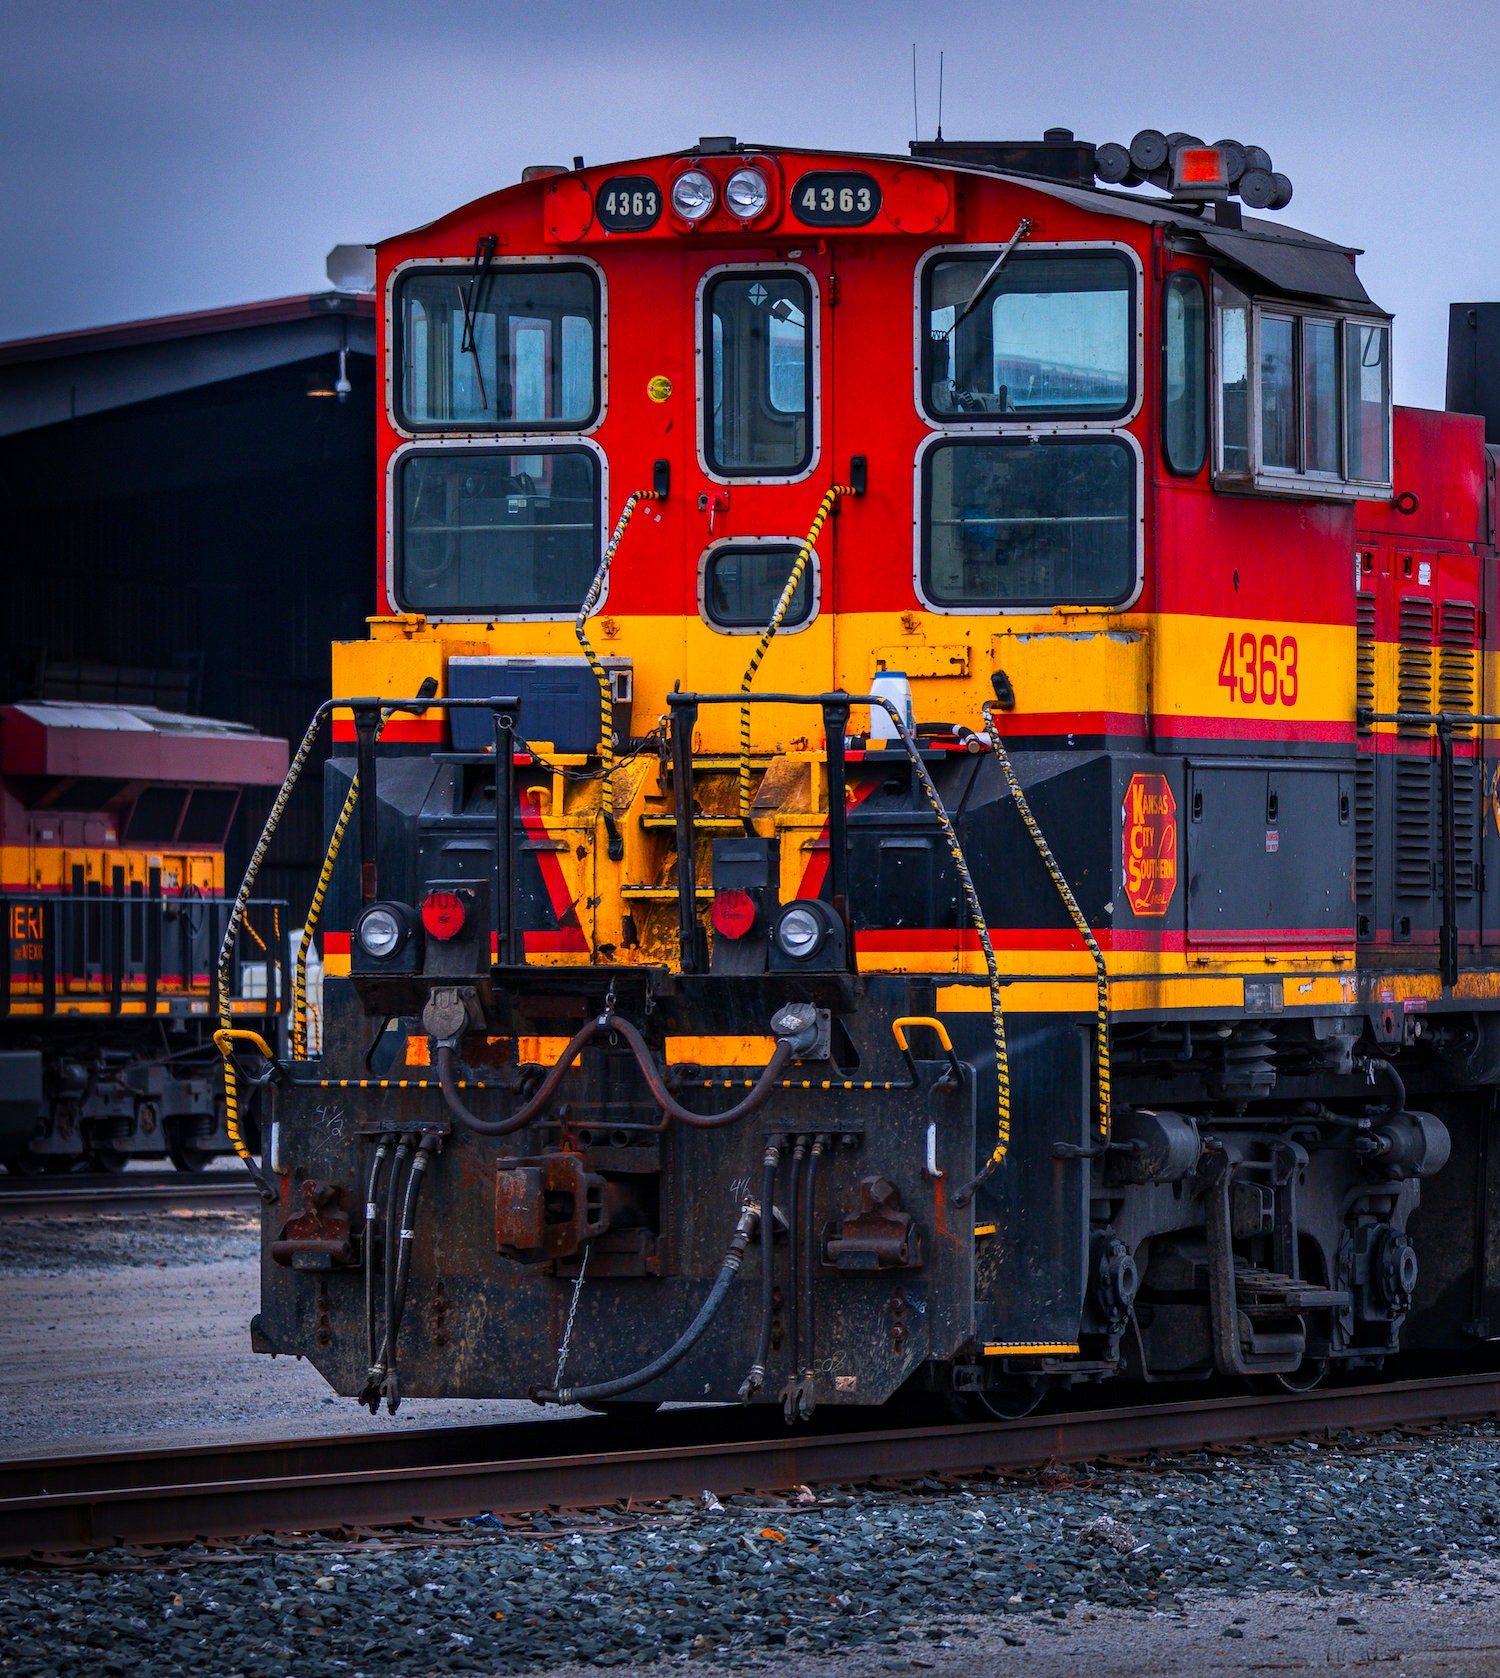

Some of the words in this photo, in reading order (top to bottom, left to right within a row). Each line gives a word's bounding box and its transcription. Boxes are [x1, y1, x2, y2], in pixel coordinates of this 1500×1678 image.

[606, 192, 656, 216] 4363
[802, 187, 871, 212] 4363
[1218, 632, 1299, 707] 4363
[1132, 783, 1169, 825] KANSAS
[1130, 825, 1155, 859] CITY
[1128, 855, 1174, 893] SOUTHERN
